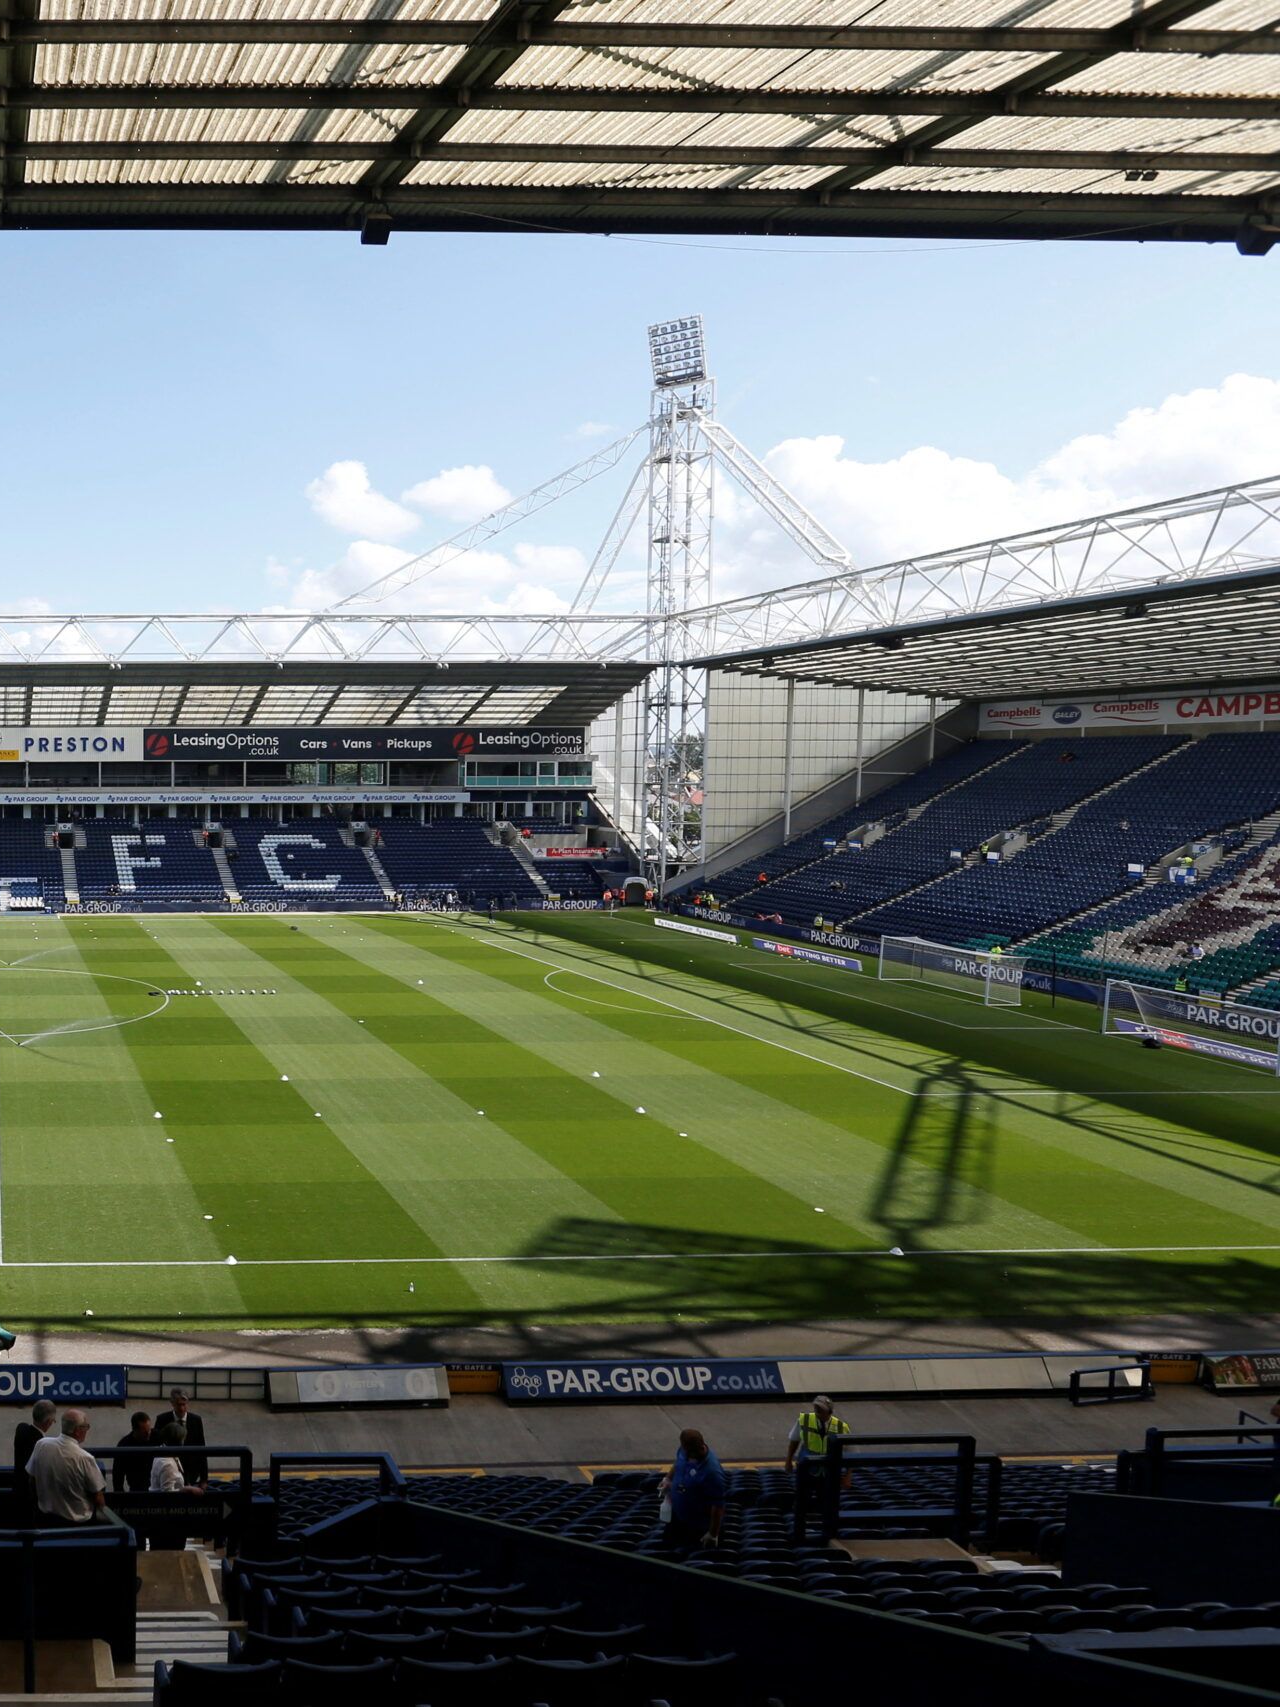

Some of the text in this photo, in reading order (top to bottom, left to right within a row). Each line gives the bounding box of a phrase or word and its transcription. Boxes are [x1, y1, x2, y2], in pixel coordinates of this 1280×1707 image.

[987, 706, 1041, 719] Campbells
[1053, 710, 1080, 719] BAILEY
[1092, 700, 1160, 715] Campbells
[24, 736, 125, 752] PRESTON
[174, 733, 279, 749] LeasingOptions
[300, 738, 433, 752] Cars Vans Pickups
[479, 732, 582, 748] LeasingOptions
[248, 746, 279, 756] .co.uk
[552, 744, 582, 754] .co.uk
[111, 835, 166, 892] F
[258, 834, 341, 891] C
[64, 904, 143, 914] PAR-GROUP.co.uk
[231, 903, 308, 913] PAR-GROUP.co.uk
[694, 906, 746, 928] PAR-GROUP.co.uk
[811, 930, 880, 955] PAR-GROUP.co.uk
[763, 942, 846, 966] sky bet BETTING BETTER
[954, 959, 1052, 991] PAR-GROUP.co.uk
[546, 1366, 778, 1394] PAR-GROUP.co.uk
